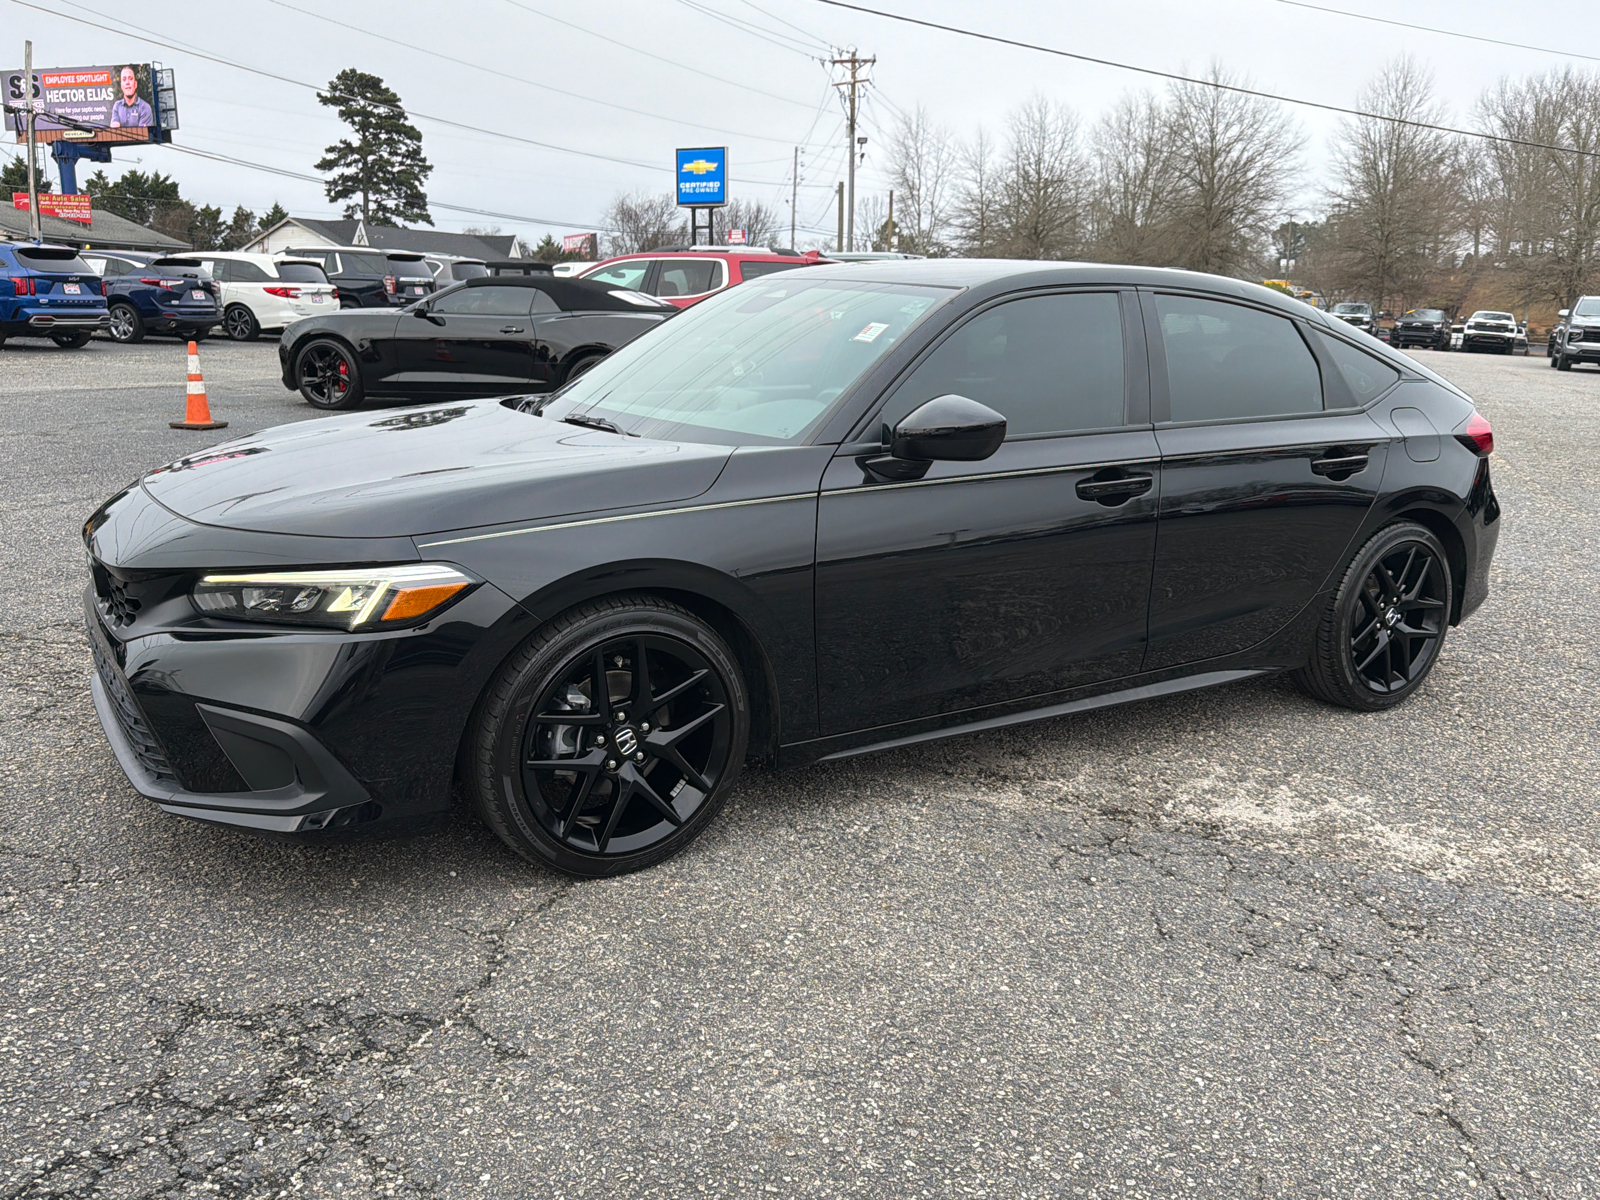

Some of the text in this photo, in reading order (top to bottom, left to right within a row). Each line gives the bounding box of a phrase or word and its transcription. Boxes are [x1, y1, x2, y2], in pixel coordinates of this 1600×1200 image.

[45, 73, 108, 84] EMPLOYEE SPOTLIGHT
[46, 87, 114, 103] HECTOR ELIAS
[81, 106, 93, 114] septic
